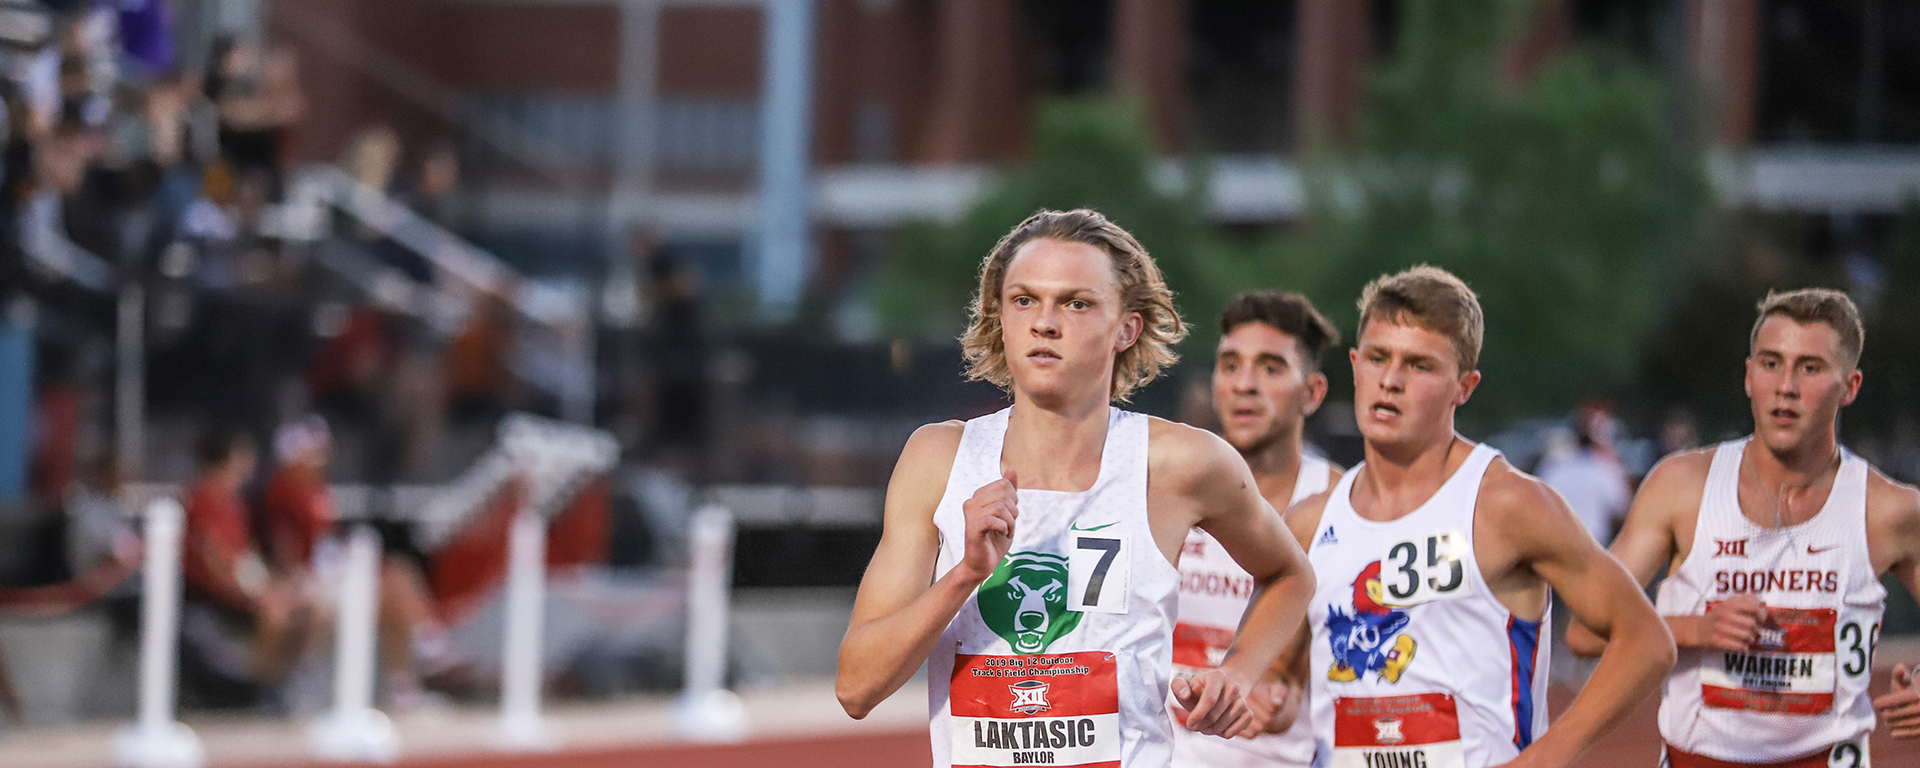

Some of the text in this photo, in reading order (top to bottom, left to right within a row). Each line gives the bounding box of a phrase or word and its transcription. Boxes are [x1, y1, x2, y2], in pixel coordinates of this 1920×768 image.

[1712, 539, 1749, 558] XII
[1077, 537, 1121, 606] 7
[1388, 535, 1463, 599] 35
[1715, 570, 1838, 593] SOONERS
[972, 665, 1089, 677] Track & Field Championship
[985, 656, 1074, 667] 2019 Big 12 Outdoor
[1724, 652, 1812, 677] WARREN
[1011, 686, 1049, 708] XII
[974, 718, 1096, 749] LAKTASIC
[1013, 751, 1055, 764] BAYLOR
[1363, 750, 1427, 768] YOUNG
